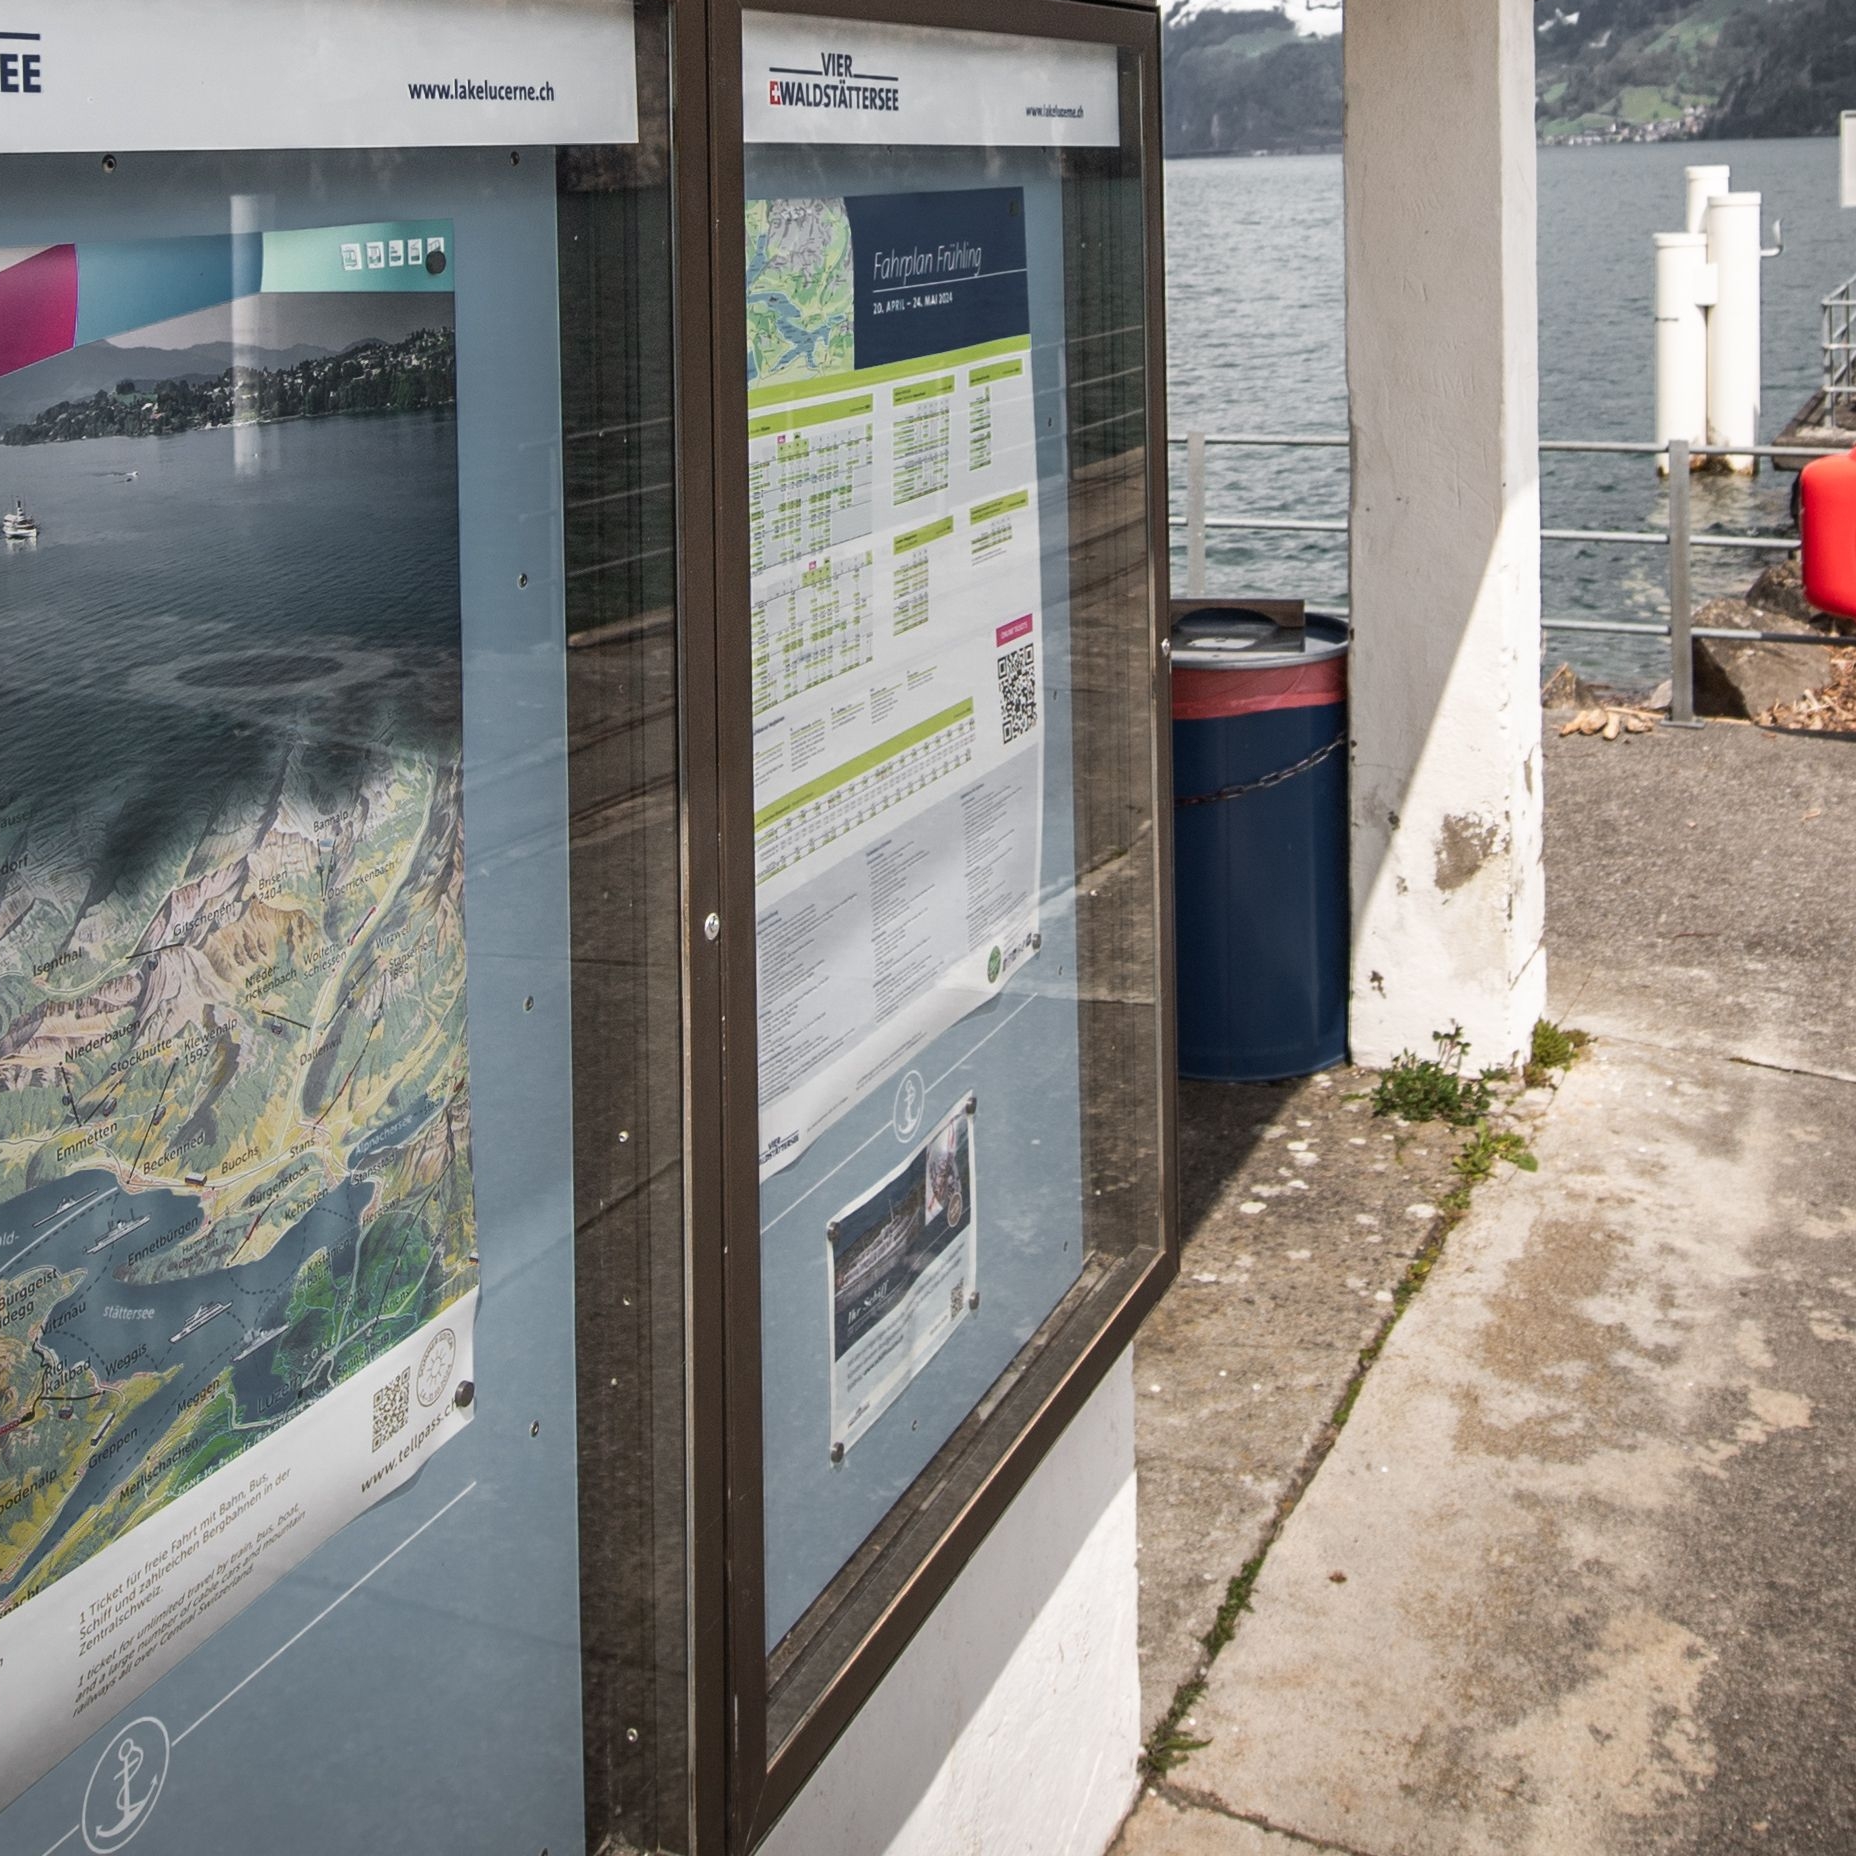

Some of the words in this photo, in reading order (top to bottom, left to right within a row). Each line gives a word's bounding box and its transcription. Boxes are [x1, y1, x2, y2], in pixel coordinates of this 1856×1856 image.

[821, 51, 853, 78] VIER
[408, 78, 555, 102] www.lakelucerne.ch
[780, 80, 900, 112] WALDSTÄTTERSEE
[873, 246, 933, 286] Fahrplan
[937, 240, 982, 277] Frühling
[873, 302, 884, 315] 20.
[886, 299, 905, 313] APRIL
[924, 294, 937, 307] MAI
[33, 946, 83, 978] Isenthal
[64, 1020, 142, 1064] Niederbauen
[110, 1036, 174, 1077] Stockhütte
[183, 1045, 211, 1068] 1593
[55, 1121, 119, 1163] Emmetten
[143, 1130, 206, 1176] Beckenried
[221, 1146, 260, 1176] Buochs
[289, 1136, 316, 1160] Stans
[248, 1162, 311, 1209] Bürgenstock
[284, 1187, 330, 1222] Kehrsiten
[126, 1215, 199, 1267] Ennetbürgen
[39, 1301, 87, 1336] Vitznau
[103, 1304, 156, 1321] stättersee
[44, 1358, 68, 1380] Rigi
[45, 1356, 92, 1395] Kaltbad
[105, 1342, 148, 1378] Weggis
[176, 1378, 221, 1416] Meggen
[256, 1372, 305, 1415] Luzern
[88, 1426, 138, 1470] Greppen
[360, 1396, 458, 1494] www.tellpass.ch
[119, 1437, 200, 1504] Merlischachen
[79, 1608, 113, 1641] Schiff
[114, 1592, 137, 1615] und
[138, 1542, 201, 1598] zahlreichen
[202, 1491, 262, 1546] Bergbahnen
[264, 1481, 274, 1497] in
[275, 1467, 292, 1490] der
[79, 1611, 86, 1625] 1
[89, 1586, 124, 1618] Ticket
[126, 1570, 143, 1592] für
[144, 1548, 169, 1577] freie
[171, 1528, 198, 1554] Fahrt
[199, 1514, 217, 1537] mit
[75, 1678, 97, 1704] and
[108, 1647, 135, 1680] large
[136, 1615, 179, 1657] number
[260, 1509, 307, 1555] mountain
[86, 1651, 118, 1681] ticket
[119, 1635, 134, 1655] for
[136, 1593, 186, 1642] unlimited
[187, 1571, 216, 1601] travel
[216, 1556, 228, 1578] by
[276, 1502, 300, 1528] boat
[79, 1586, 164, 1657] Zentralschweiz.
[160, 1615, 196, 1648] Central
